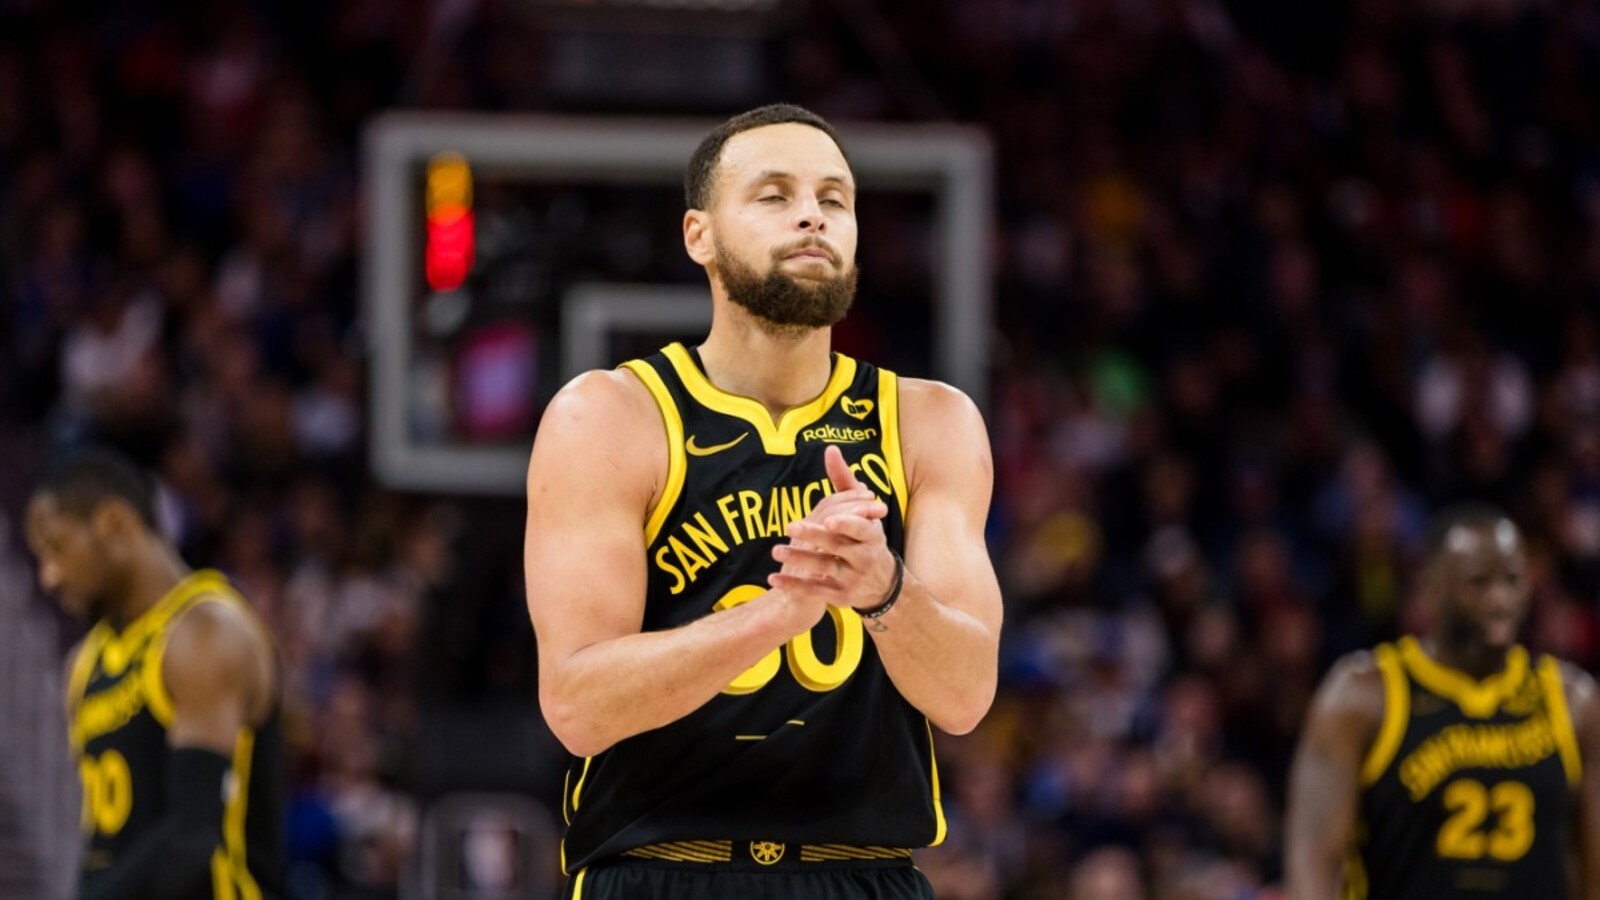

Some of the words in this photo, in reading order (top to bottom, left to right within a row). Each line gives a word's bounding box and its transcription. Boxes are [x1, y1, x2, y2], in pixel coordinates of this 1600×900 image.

[802, 424, 878, 443] Rakuten
[847, 403, 869, 415] DM
[655, 511, 730, 595] SAN
[716, 453, 893, 546] FRANCO
[1435, 777, 1536, 862] 23
